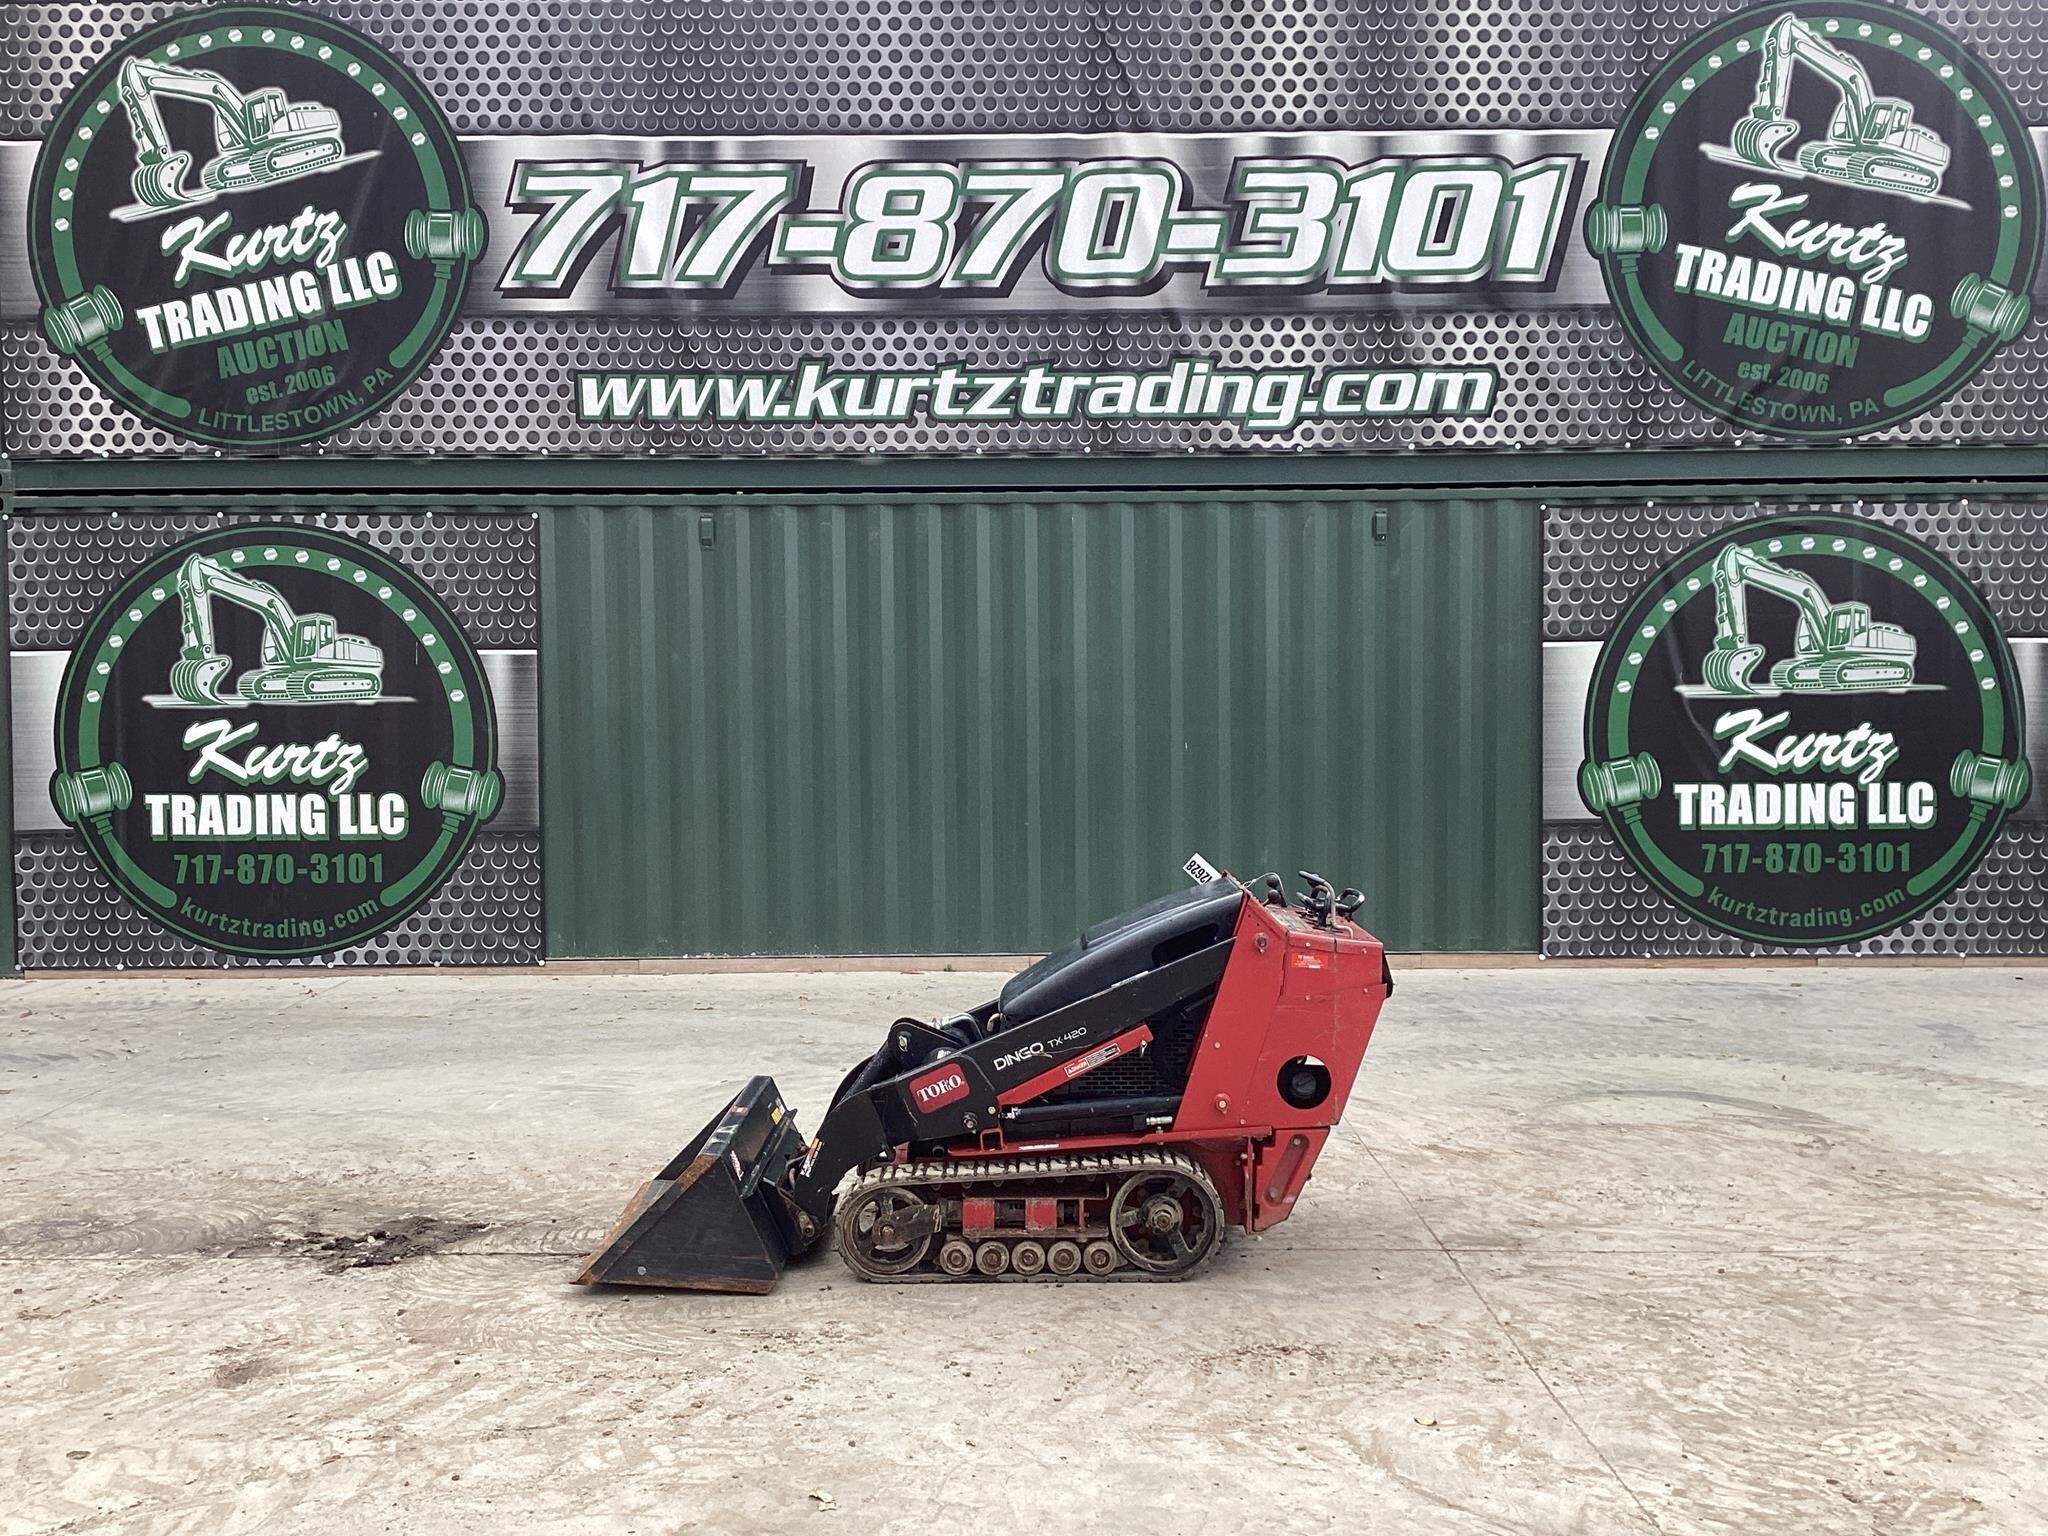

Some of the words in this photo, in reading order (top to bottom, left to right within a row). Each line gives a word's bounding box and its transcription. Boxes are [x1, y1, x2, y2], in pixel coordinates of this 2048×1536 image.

[161, 206, 348, 286] Kurtz
[503, 162, 1578, 290] 717-870-3101
[1726, 182, 1909, 284] Kurtz
[137, 269, 324, 352] TRADING
[327, 251, 402, 310] LLC
[1674, 244, 1856, 326] TRADING
[1860, 284, 1934, 342] LLC
[216, 319, 349, 379] AUCTION
[1723, 312, 1861, 368] AUCTION
[198, 390, 365, 433] LITTLESTOWN,
[362, 368, 394, 396] PA
[246, 379, 282, 405] est.
[285, 365, 336, 396] 2006
[577, 358, 1500, 432] www.kurtztrading.com
[1682, 359, 1844, 424] LITTLESTOWN,
[1850, 398, 1879, 420] PA
[1738, 360, 1773, 384] est.
[1776, 365, 1830, 395] 2006
[183, 719, 369, 795] Kurtz
[1713, 708, 1899, 784] Kurtz
[145, 794, 329, 840] TRADING
[338, 792, 409, 840] LLC
[1674, 782, 1858, 829] TRADING
[1865, 781, 1937, 829] LLC
[174, 853, 383, 884] 717-870-3101
[1703, 842, 1910, 873] 717-870-3101
[180, 897, 379, 938] kurtztrading.com
[1708, 886, 1905, 927] kurtztrading.com
[993, 1042, 1044, 1071] DINGO
[916, 1074, 962, 1102] TORO
